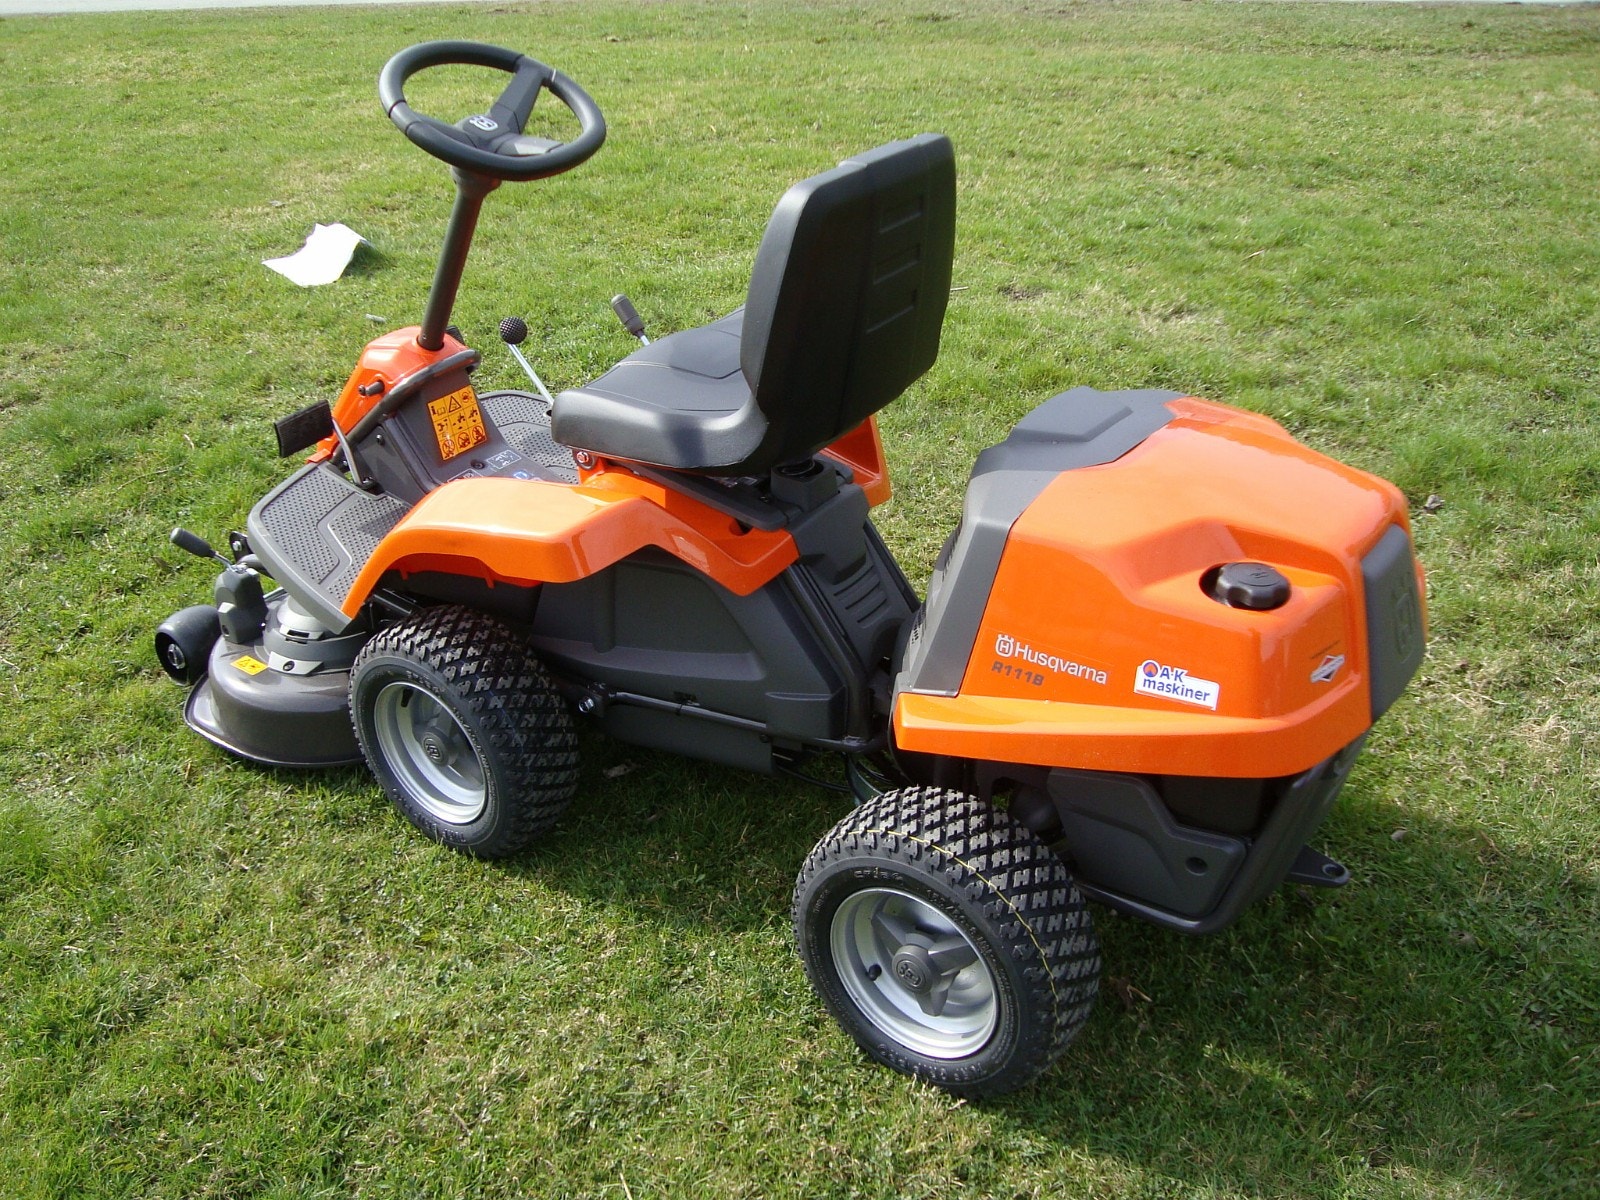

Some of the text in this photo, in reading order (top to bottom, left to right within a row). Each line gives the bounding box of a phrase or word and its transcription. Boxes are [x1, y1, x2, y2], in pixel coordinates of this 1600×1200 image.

[991, 660, 1045, 686] R111B
[1014, 641, 1107, 685] Husqvarna
[1142, 678, 1211, 701] maskiner
